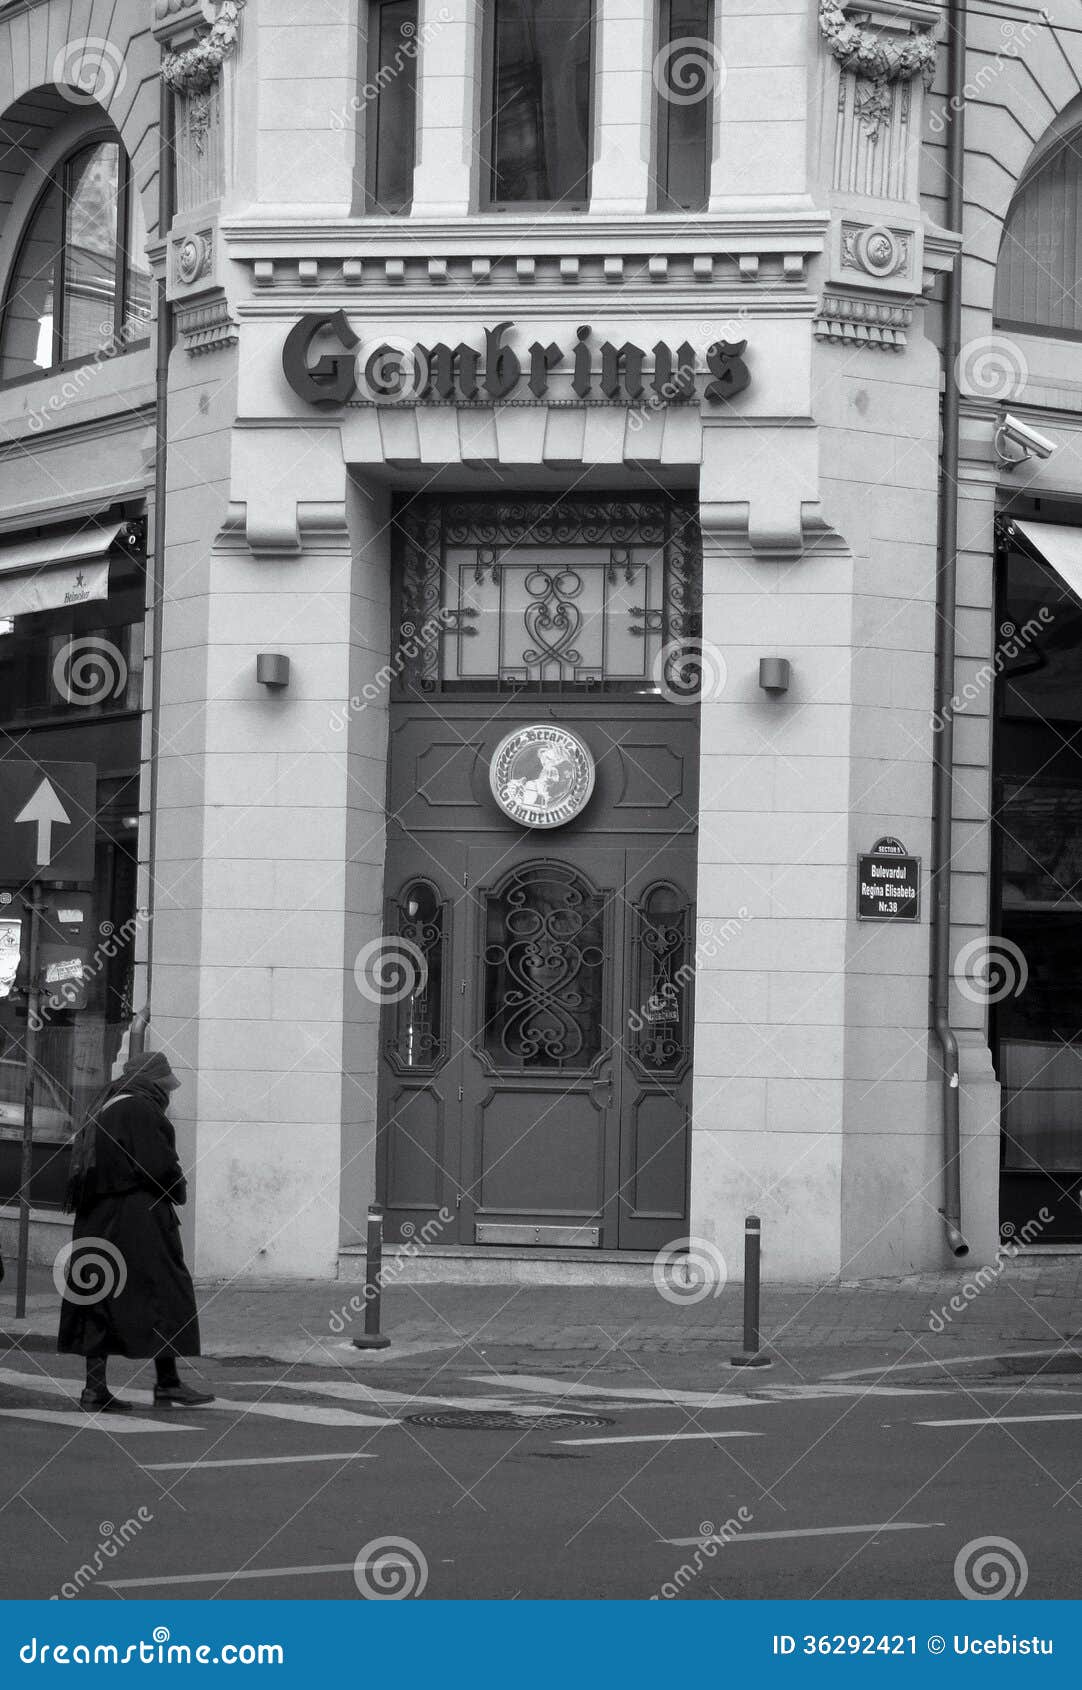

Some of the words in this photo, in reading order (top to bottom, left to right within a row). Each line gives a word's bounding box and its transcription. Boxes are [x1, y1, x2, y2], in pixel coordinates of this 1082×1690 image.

[282, 309, 752, 413] Gambrinus
[871, 864, 907, 879] Bulevardul
[861, 882, 884, 899] Regina
[885, 883, 916, 898] Elisabeta
